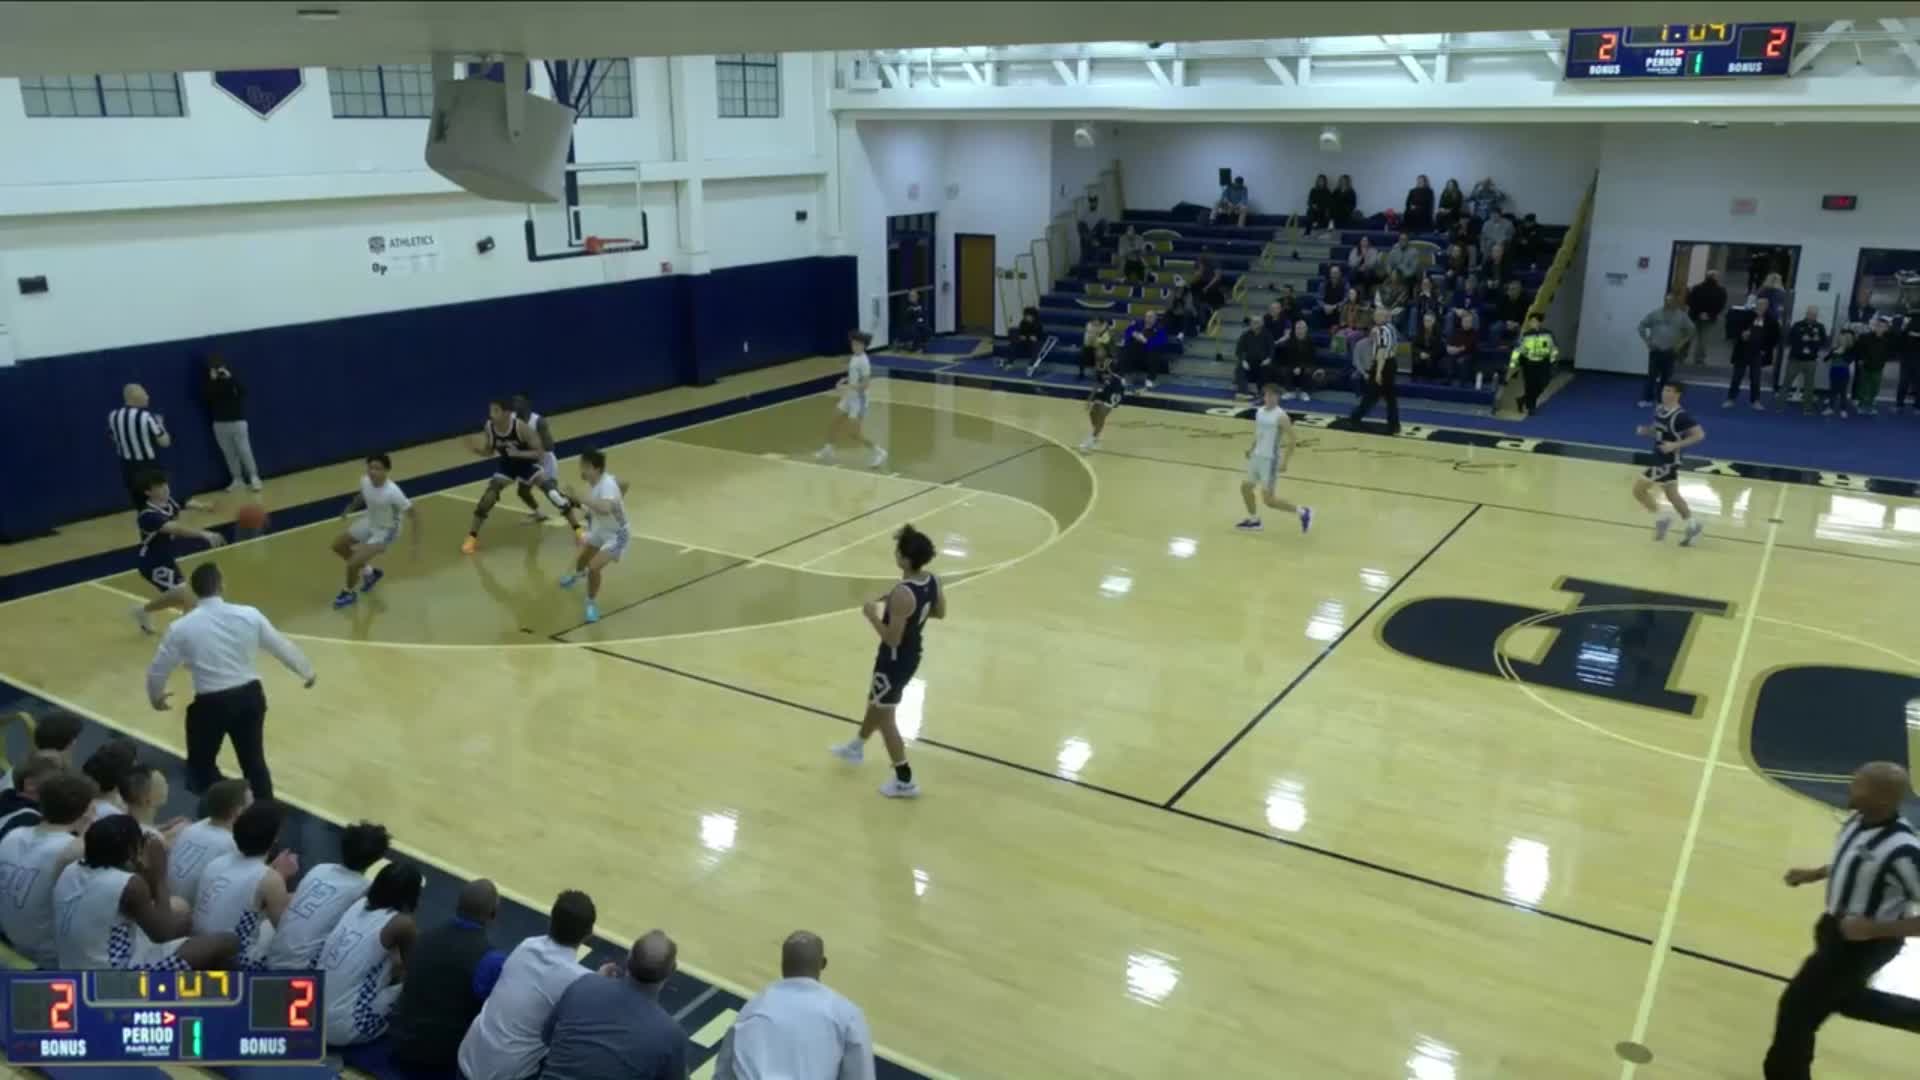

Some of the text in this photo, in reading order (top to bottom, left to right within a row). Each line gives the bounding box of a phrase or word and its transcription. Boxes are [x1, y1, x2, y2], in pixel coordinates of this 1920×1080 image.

[1598, 33, 1617, 60] 2
[1767, 28, 1787, 57] 2
[1589, 64, 1621, 75] BONUS
[1645, 57, 1682, 67] PERIOD
[1694, 52, 1703, 74] 1
[1728, 62, 1763, 73] BONUS
